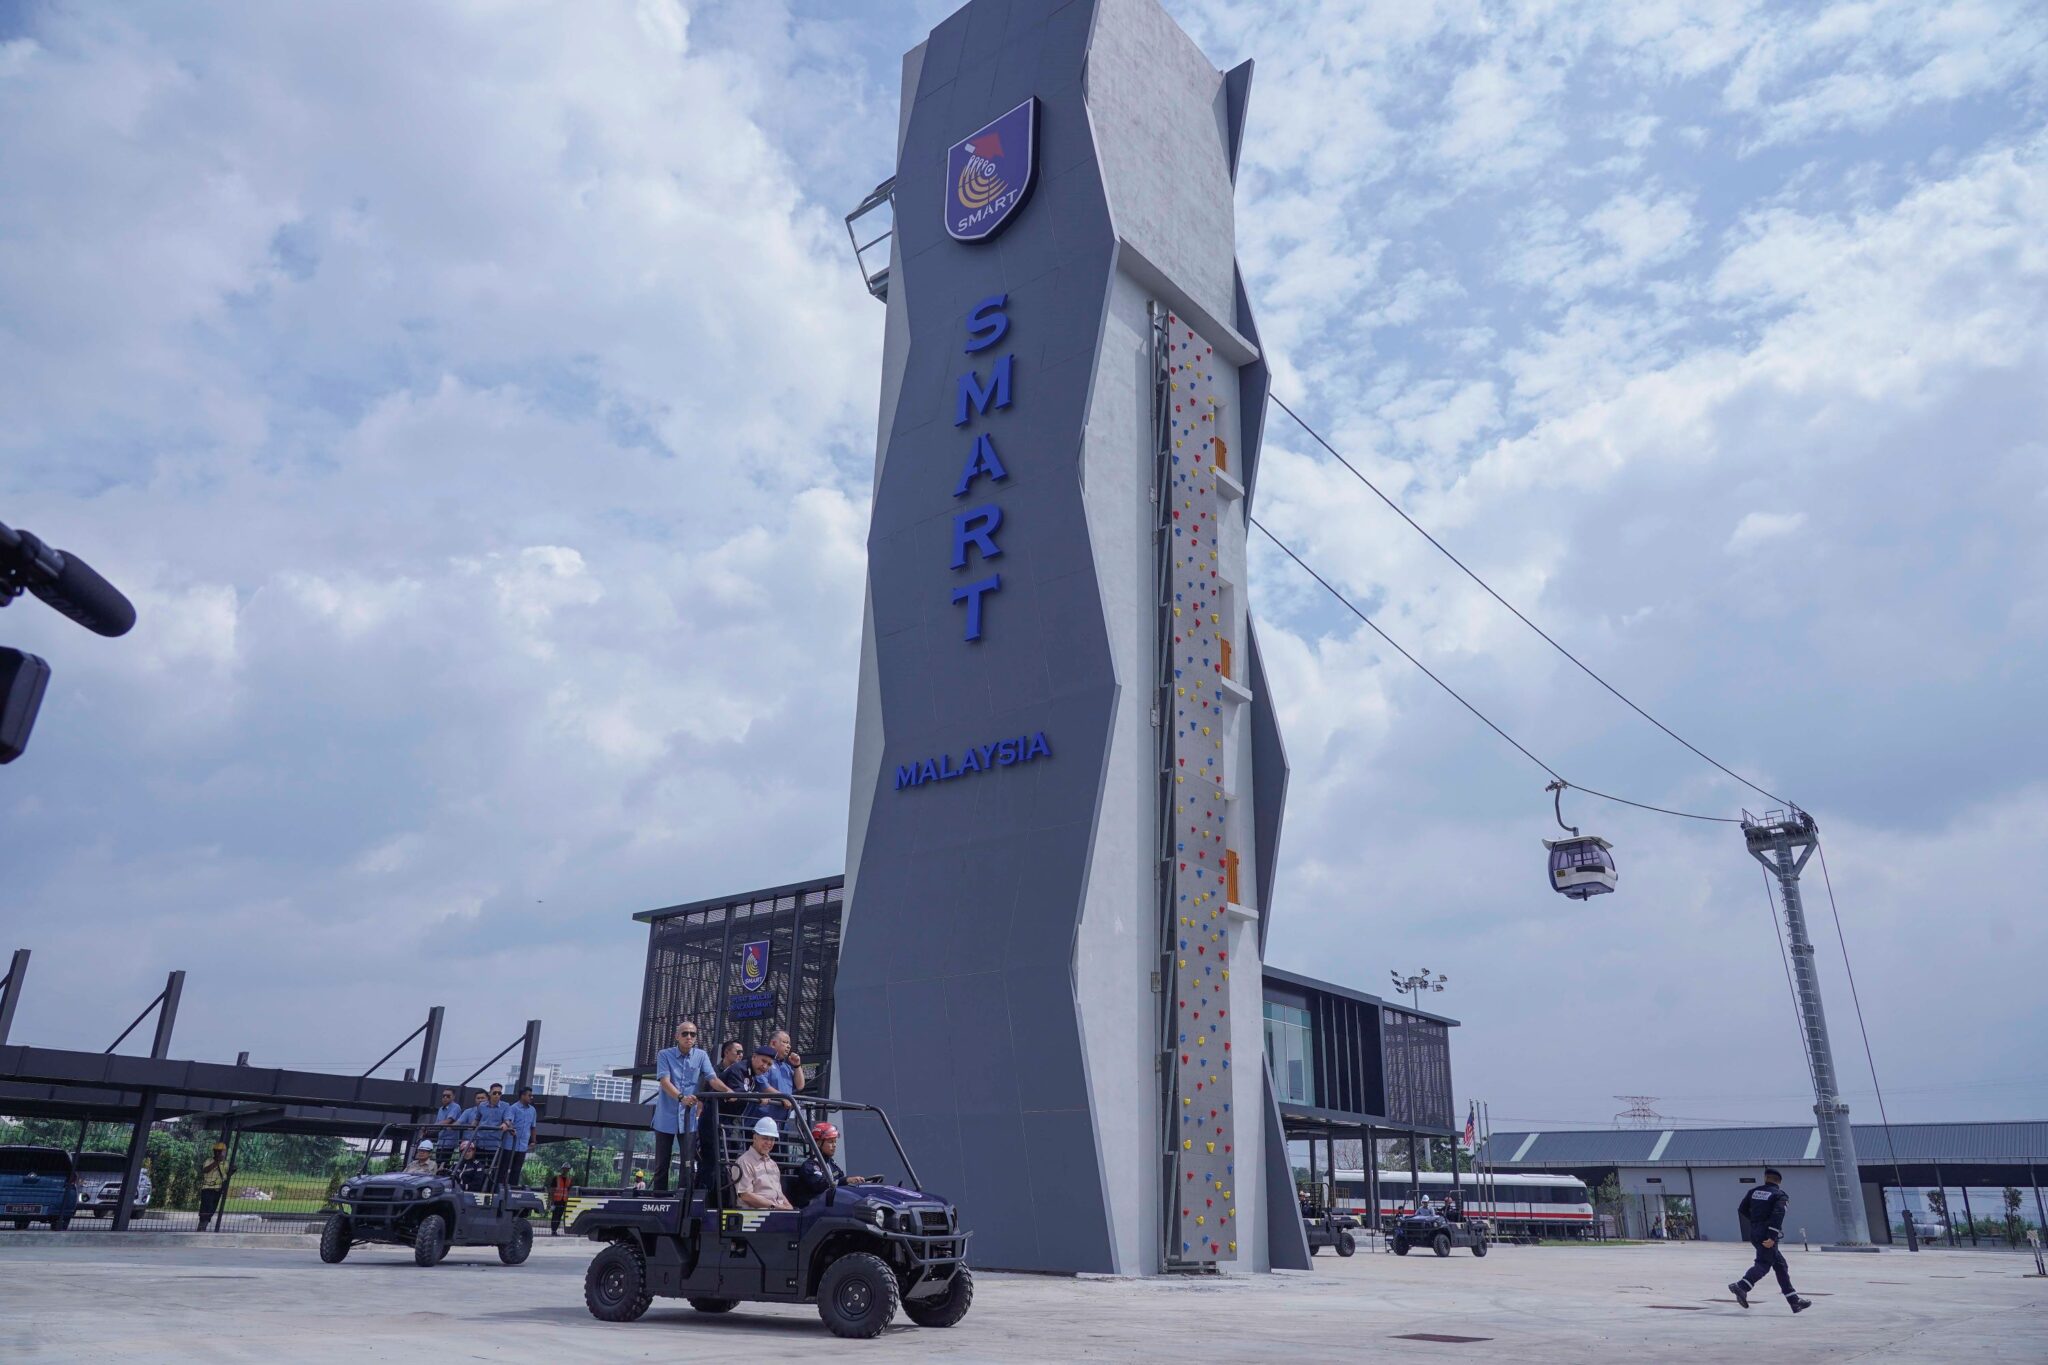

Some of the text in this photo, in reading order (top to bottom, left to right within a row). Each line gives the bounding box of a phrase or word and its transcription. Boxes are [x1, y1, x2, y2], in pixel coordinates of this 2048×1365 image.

[958, 188, 1018, 233] SMART
[951, 293, 1015, 642] SMART
[895, 731, 1053, 791] MALAYSIA
[642, 1203, 671, 1212] SMART
